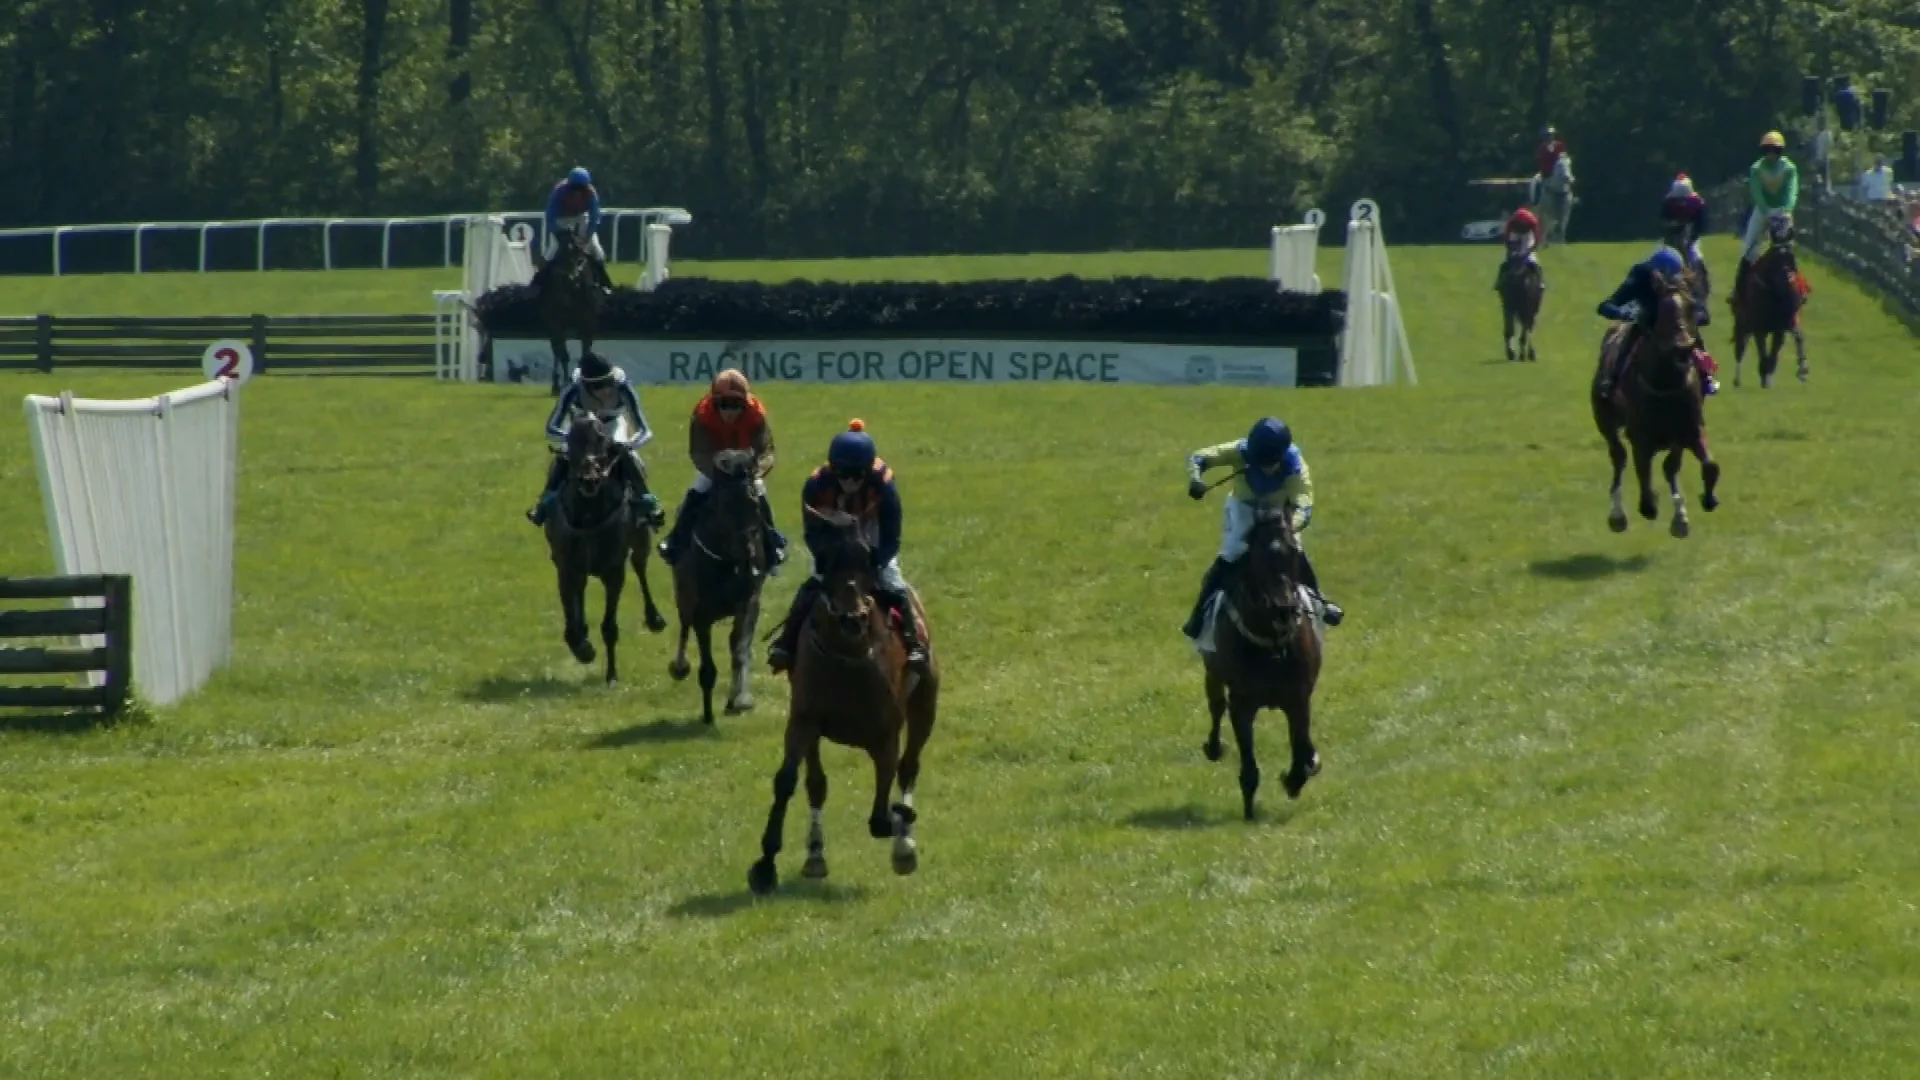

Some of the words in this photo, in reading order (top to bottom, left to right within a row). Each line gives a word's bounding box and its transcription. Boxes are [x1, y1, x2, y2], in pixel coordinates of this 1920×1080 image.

[1358, 204, 1372, 222] 2
[517, 226, 527, 241] 1
[214, 348, 240, 379] 2
[670, 351, 802, 381] RACING
[817, 351, 884, 380] FOR
[898, 351, 994, 379] OPEN
[1009, 352, 1119, 381] SPACE
